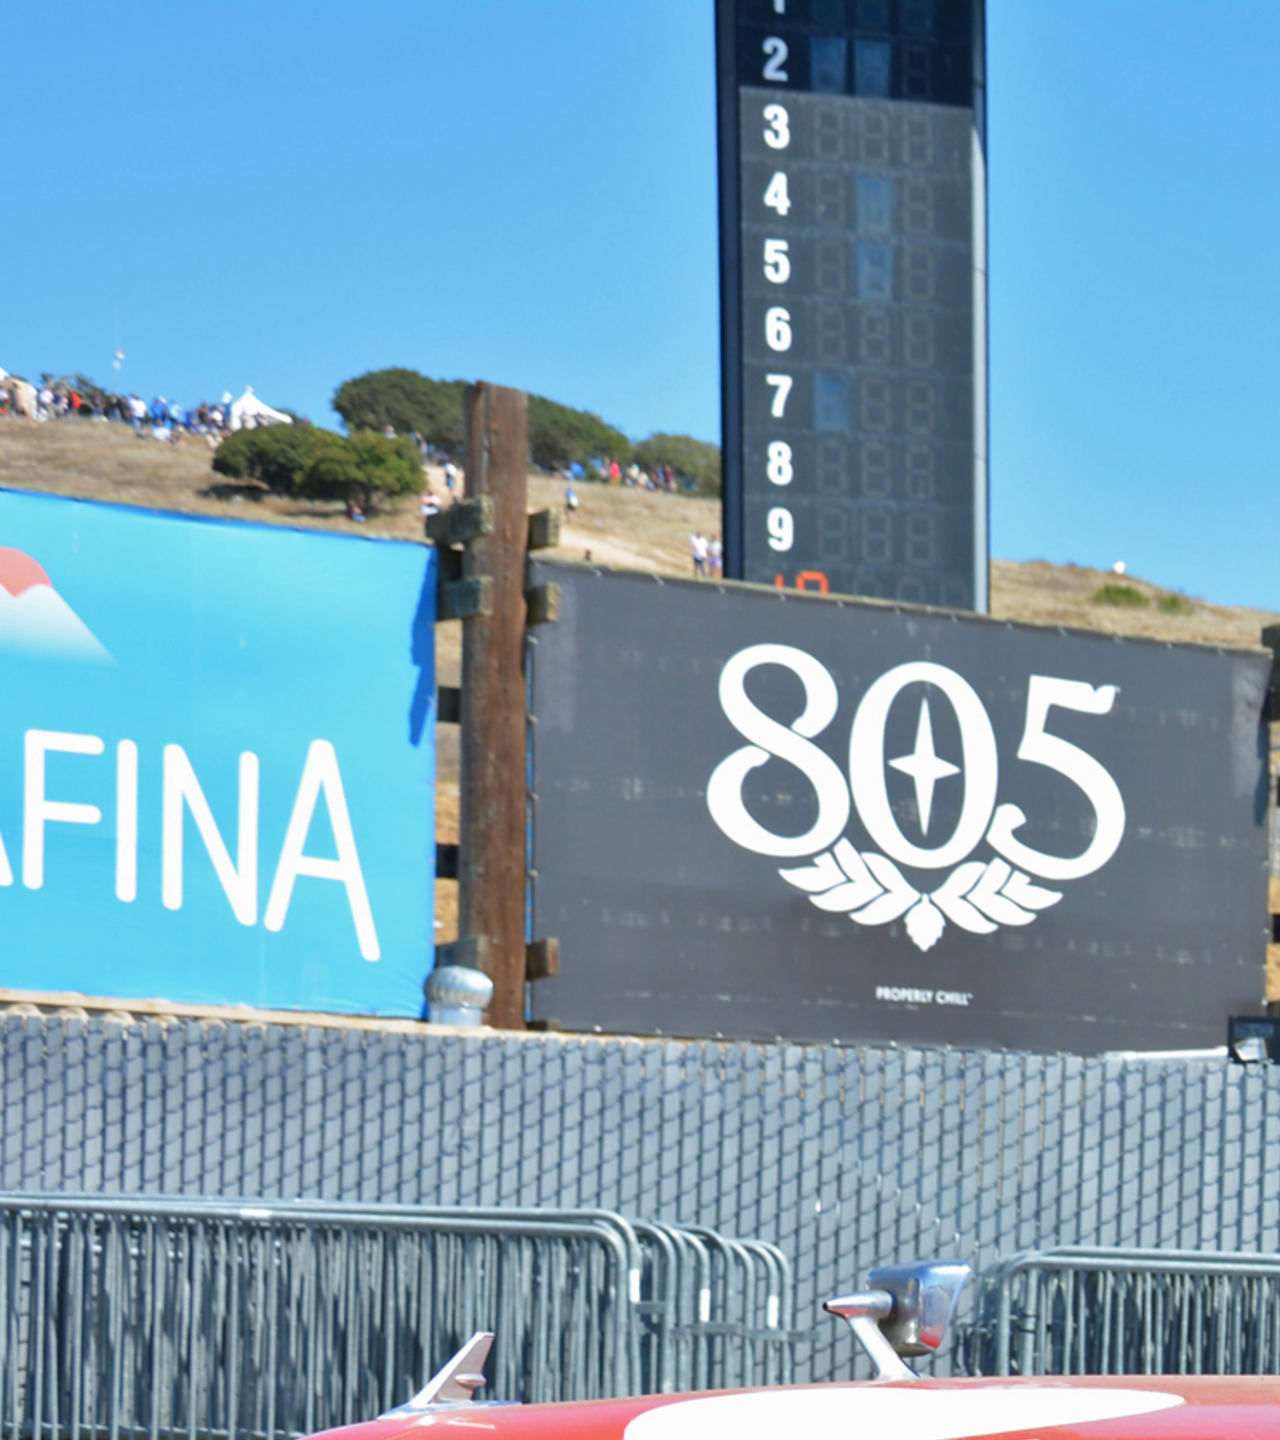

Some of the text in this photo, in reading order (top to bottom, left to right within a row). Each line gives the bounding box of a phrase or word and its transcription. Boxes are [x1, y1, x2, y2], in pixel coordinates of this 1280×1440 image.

[762, 38, 789, 81] 2
[763, 104, 790, 149] 3
[763, 171, 791, 216] 4
[763, 239, 791, 284] 5
[764, 306, 792, 352] 6
[765, 373, 793, 418] 7
[766, 440, 794, 486] 8
[767, 507, 794, 552] 9
[707, 643, 1126, 880] 805
[0, 729, 381, 962] FINA
[876, 985, 933, 1003] PROPERLY
